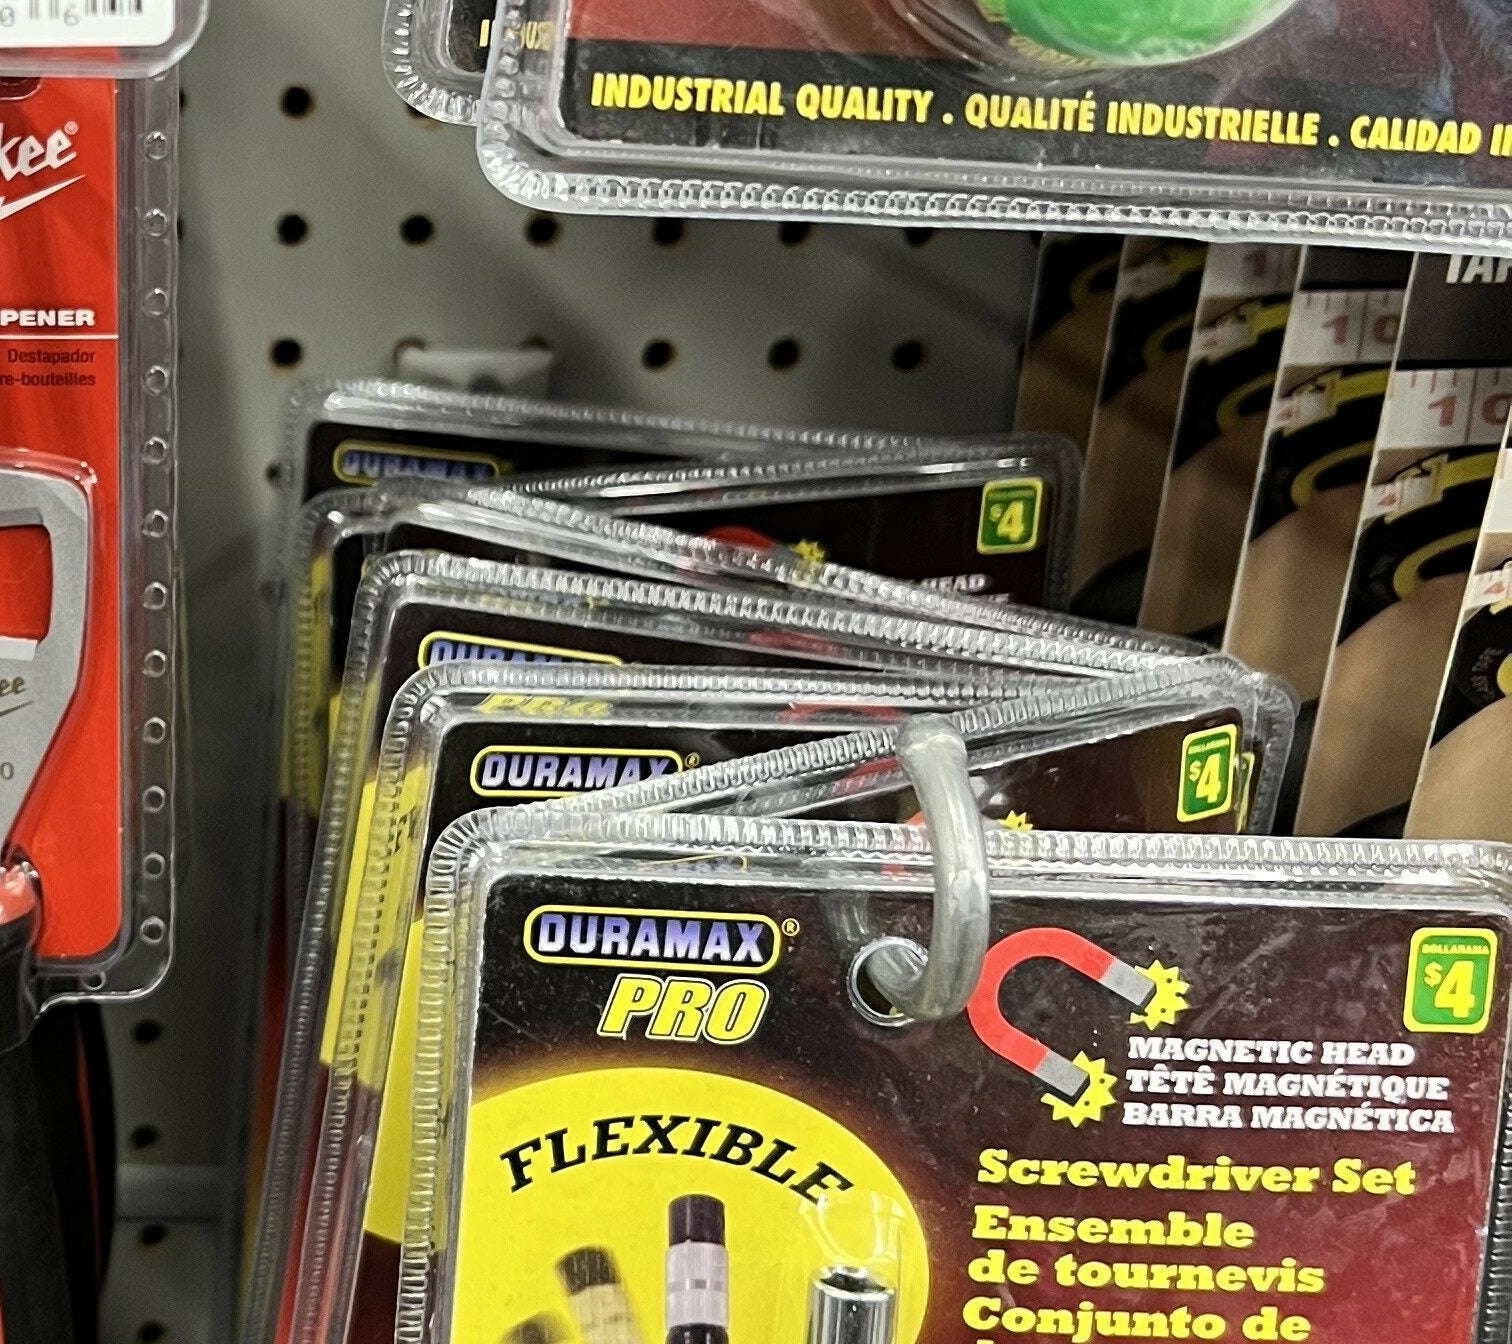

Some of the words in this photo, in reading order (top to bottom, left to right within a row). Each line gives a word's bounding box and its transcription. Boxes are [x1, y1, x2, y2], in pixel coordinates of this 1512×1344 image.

[591, 72, 785, 116] INDUSTRIAL
[796, 83, 934, 123] QUALITY
[965, 90, 1097, 132] QUALITÉ
[1106, 101, 1320, 146] INDUSTRIELLE
[1350, 115, 1482, 154] CALIDAD
[7, 346, 96, 369] Destapador
[536, 910, 765, 964] DURAMAX
[601, 976, 772, 1044] PRO
[1424, 960, 1475, 1018] $4
[1128, 1036, 1310, 1067] MAGNETIC
[1320, 1040, 1414, 1068] HEAD
[1224, 1065, 1449, 1102] MAGNÉTIQUE
[1122, 1102, 1236, 1131] BARRA
[1251, 1101, 1454, 1135] MAGNÉTICA
[500, 1114, 853, 1205] FLEXIBLE
[978, 1149, 1323, 1194] Screwdriver
[1332, 1159, 1416, 1197] Set
[973, 1205, 1255, 1249] Ensemble
[967, 1254, 1032, 1291] de
[1053, 1257, 1326, 1297] tournevis
[1241, 1308, 1310, 1343] de
